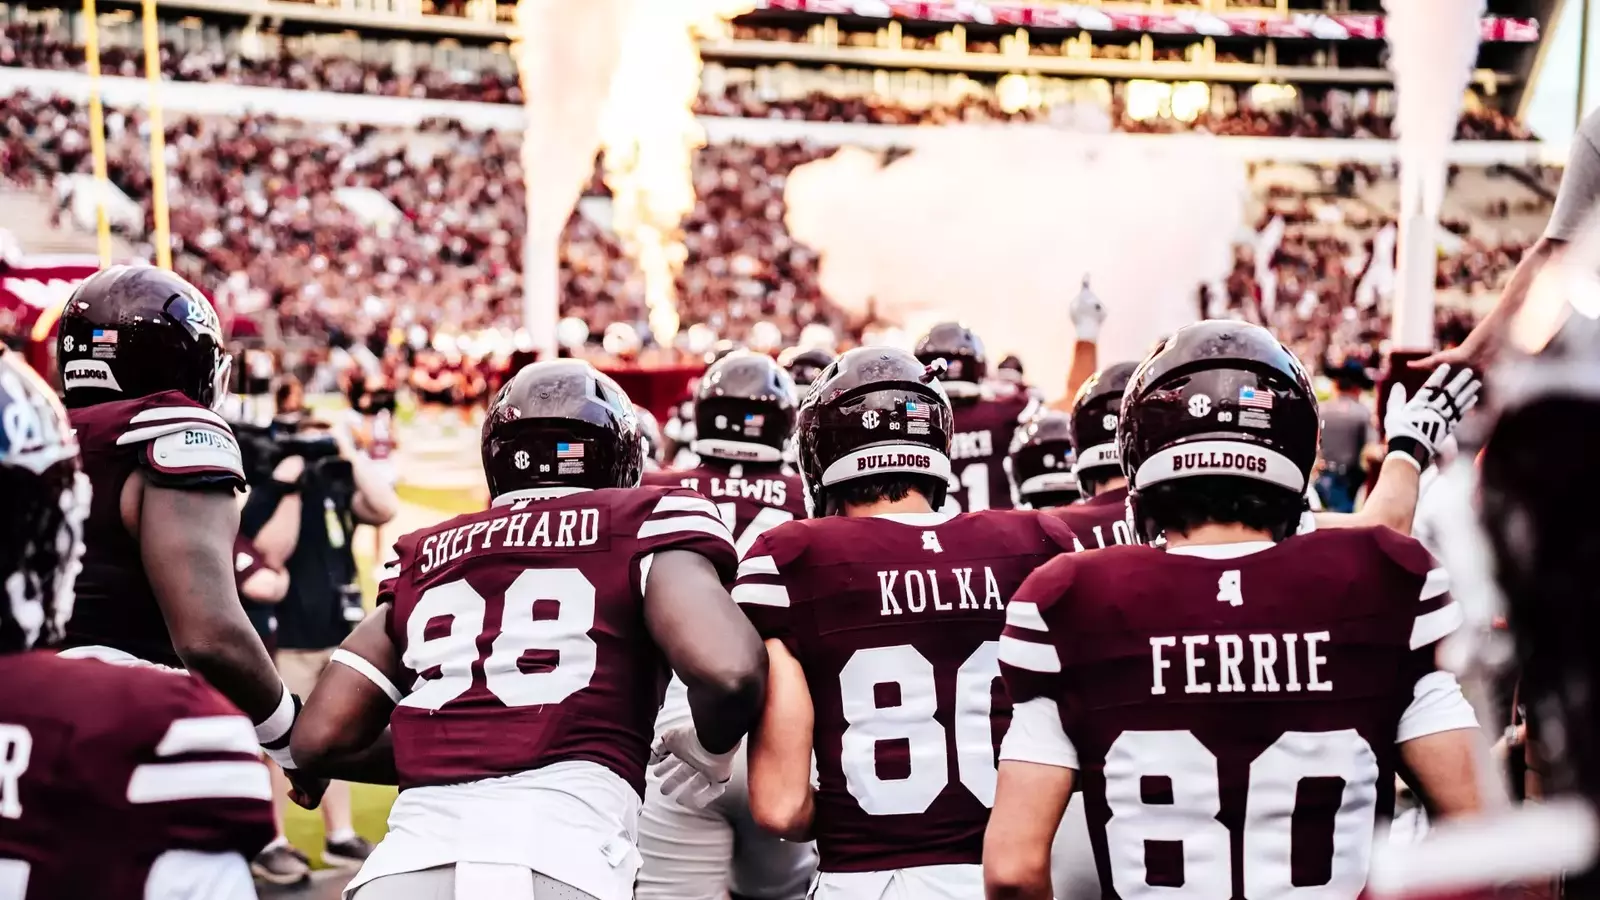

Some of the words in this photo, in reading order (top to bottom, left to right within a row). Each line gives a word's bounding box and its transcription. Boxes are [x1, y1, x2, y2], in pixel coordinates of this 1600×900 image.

[861, 410, 881, 430] SEC
[889, 422, 900, 430] 80
[514, 450, 530, 470] SEC
[857, 453, 931, 471] BULLDOGS
[1172, 452, 1267, 473] BULLDOGS
[710, 477, 787, 506] LEWIS
[420, 508, 599, 574] SHEPPHARD
[877, 566, 1005, 616] KOLKA
[400, 568, 597, 711] 98
[1149, 631, 1333, 694] FERRIE
[1103, 729, 1378, 900] 80
